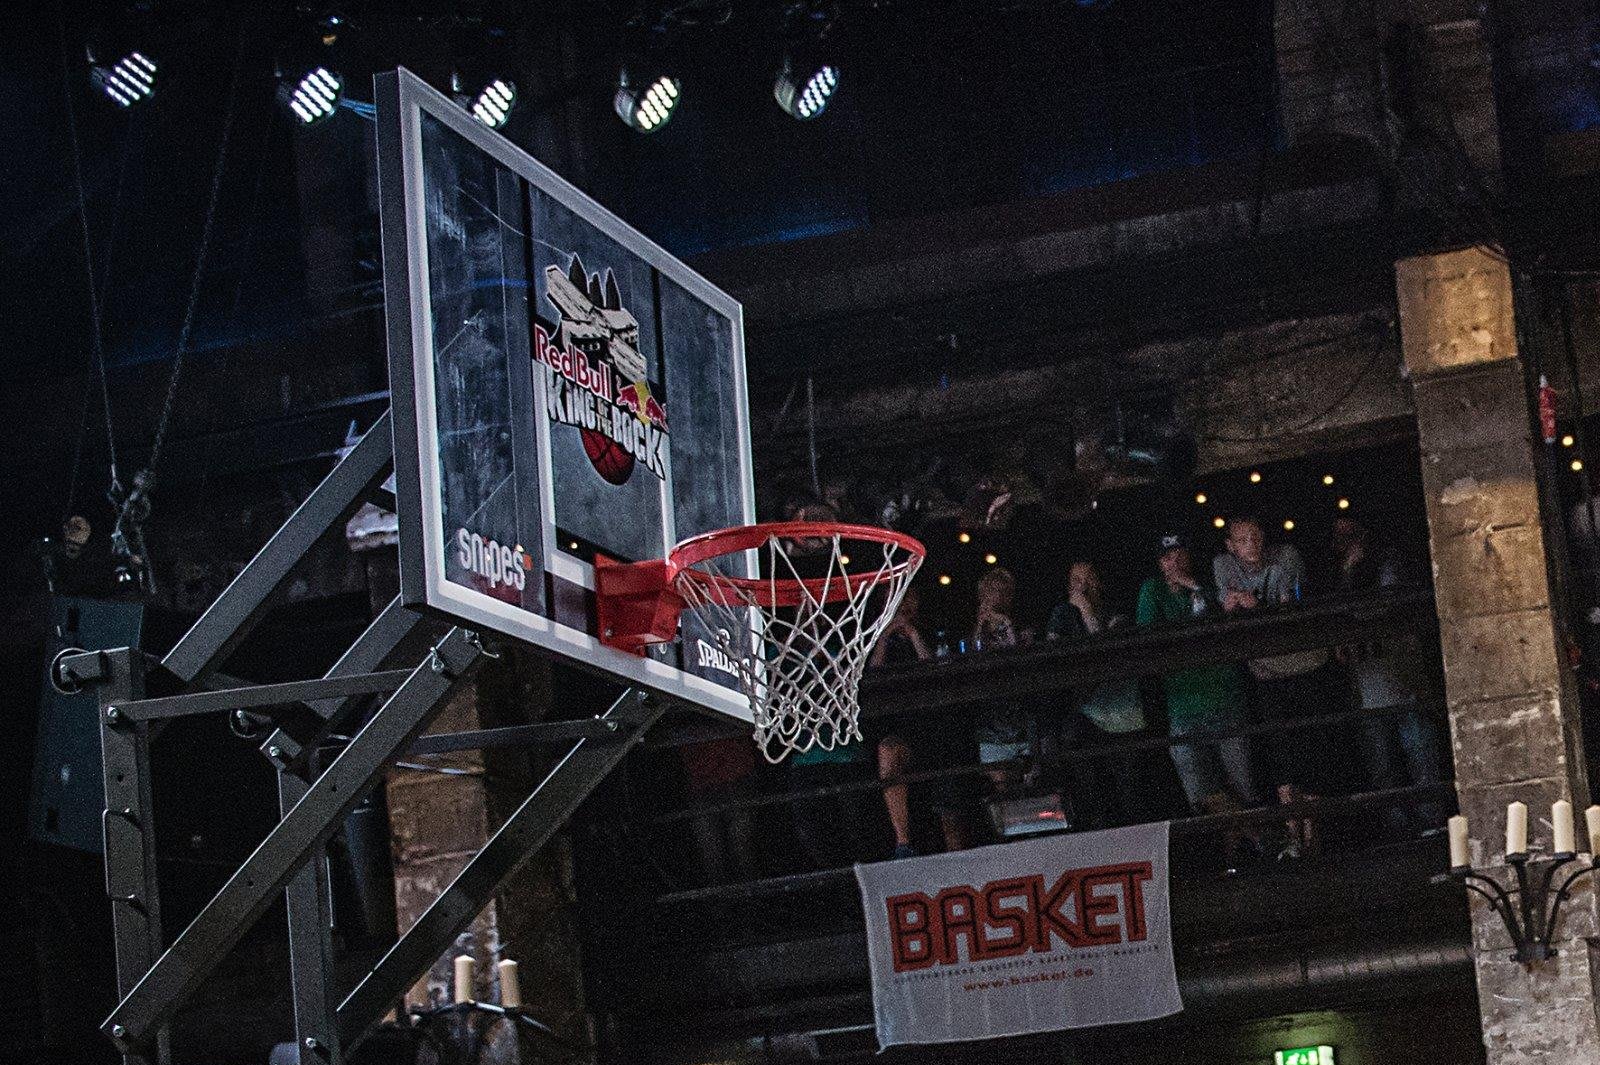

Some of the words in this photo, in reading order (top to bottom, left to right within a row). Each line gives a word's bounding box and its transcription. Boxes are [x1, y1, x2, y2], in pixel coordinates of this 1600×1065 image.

[535, 324, 574, 382] Red
[575, 349, 613, 403] Bull
[459, 528, 526, 591] snipes
[886, 860, 1153, 974] BASKET
